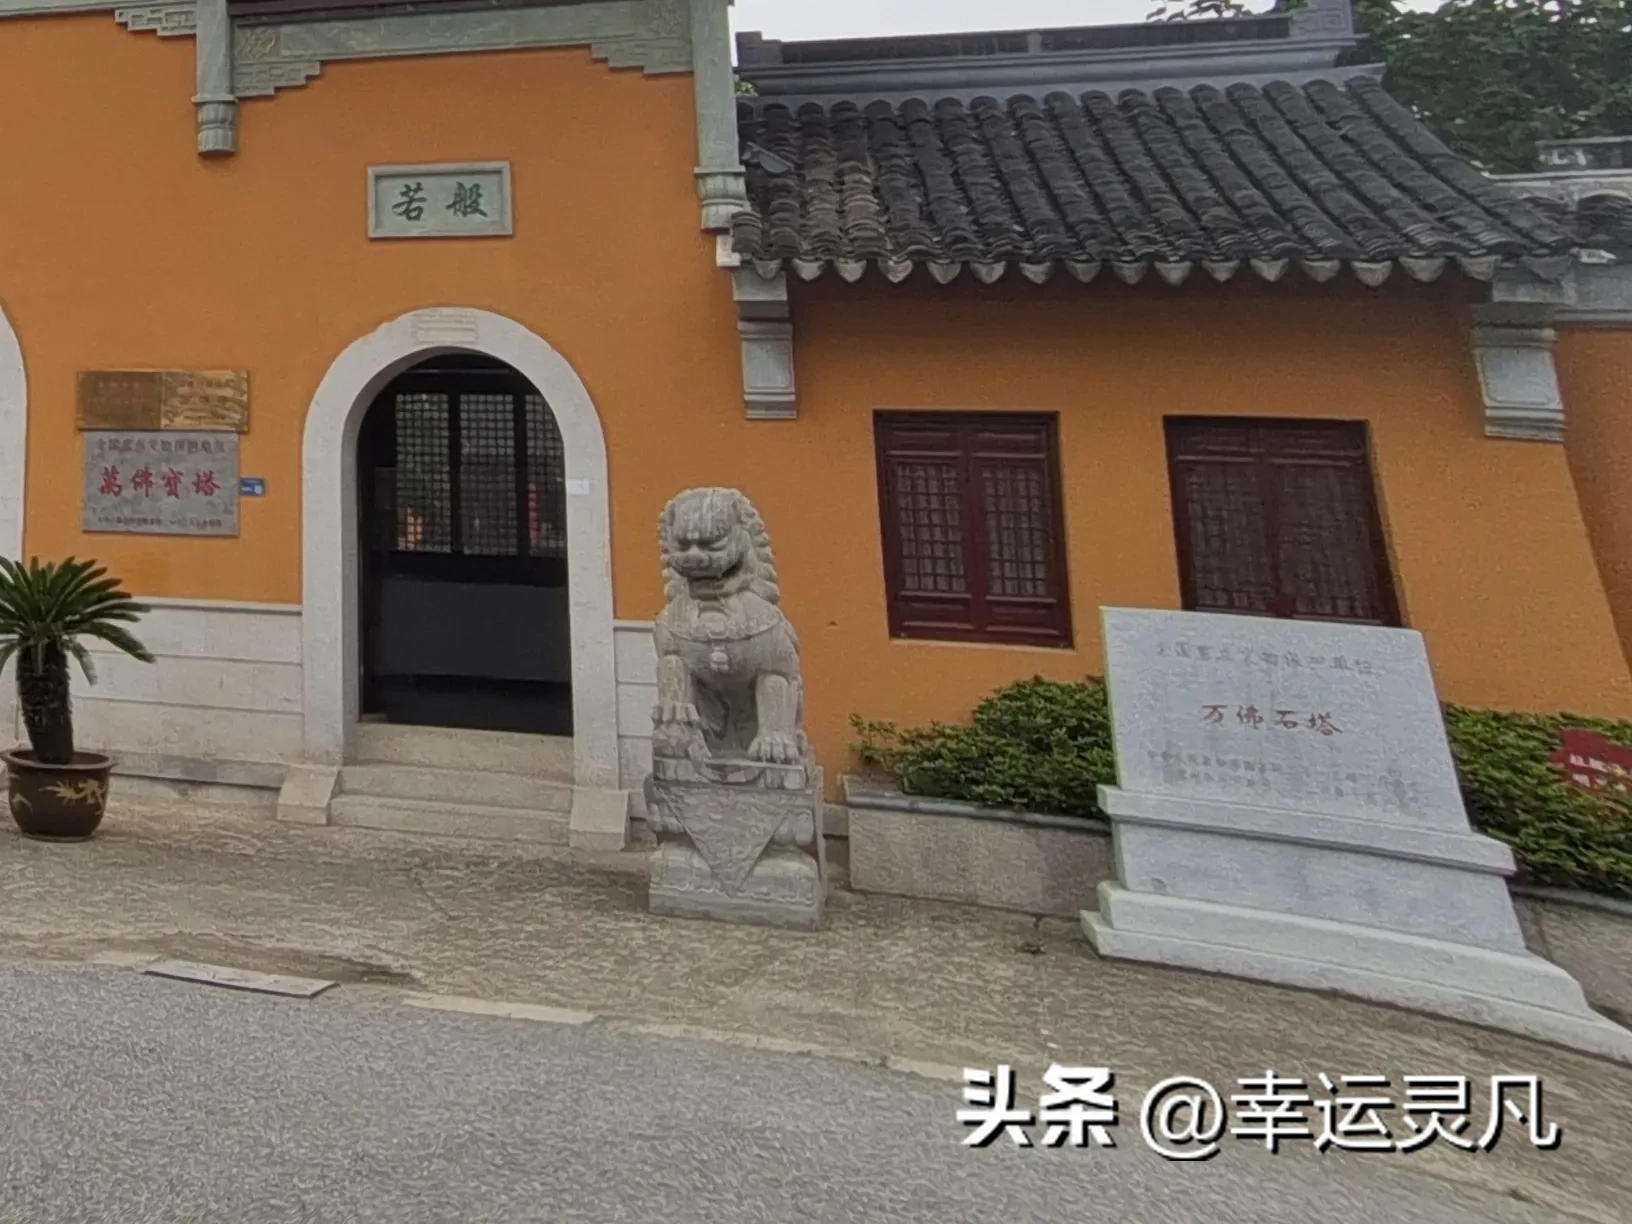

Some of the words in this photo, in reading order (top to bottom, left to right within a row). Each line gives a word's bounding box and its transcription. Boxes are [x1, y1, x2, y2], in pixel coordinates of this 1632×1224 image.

[392, 181, 489, 222] 般若
[1201, 704, 1344, 737] 万佛石塔
